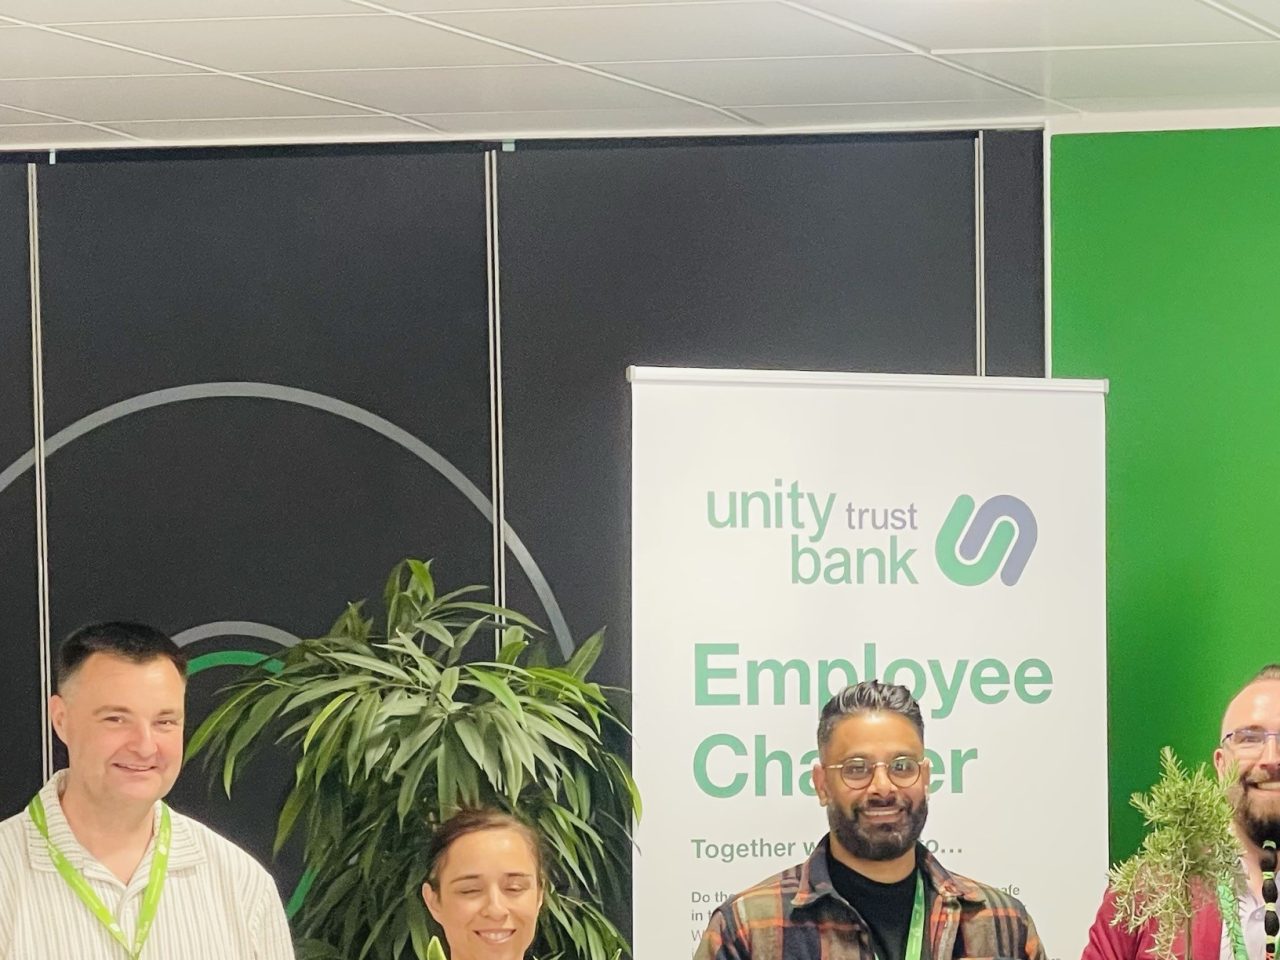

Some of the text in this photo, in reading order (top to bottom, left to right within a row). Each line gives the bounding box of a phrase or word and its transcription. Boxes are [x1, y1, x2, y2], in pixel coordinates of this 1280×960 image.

[706, 478, 919, 543] unity trust
[791, 534, 920, 585] bank
[694, 643, 1054, 720] Employee
[693, 733, 979, 799] Chaer
[691, 838, 796, 863] Together
[691, 891, 711, 903] Do
[691, 909, 703, 921] in
